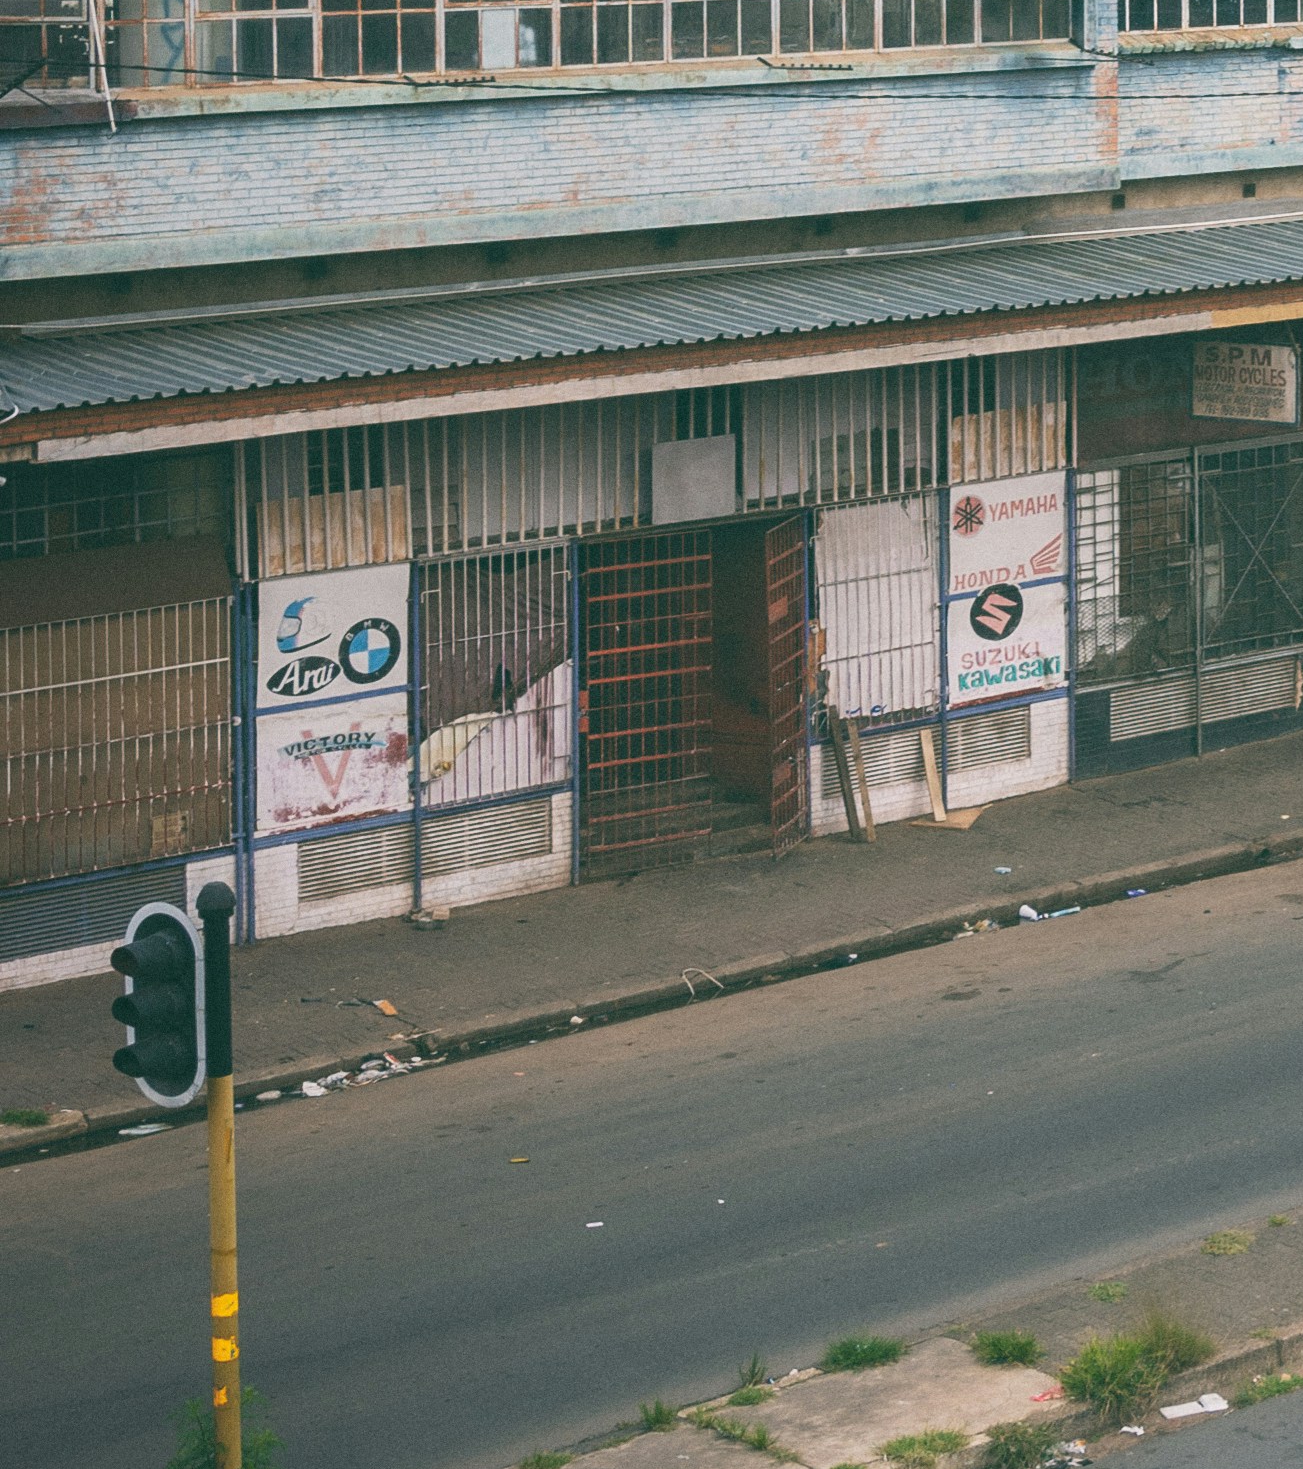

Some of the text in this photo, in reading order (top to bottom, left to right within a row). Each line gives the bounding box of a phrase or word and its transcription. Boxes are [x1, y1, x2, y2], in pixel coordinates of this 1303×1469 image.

[1205, 346, 1272, 367] S.P.M
[1194, 365, 1287, 387] MOTOR CYCLES
[988, 493, 1058, 523] YAMAHA
[953, 564, 1027, 592] HONDA
[345, 619, 390, 641] BMW
[960, 641, 1041, 670] SUZUKI
[273, 660, 336, 696] Arai
[284, 732, 376, 756] VICTORY
